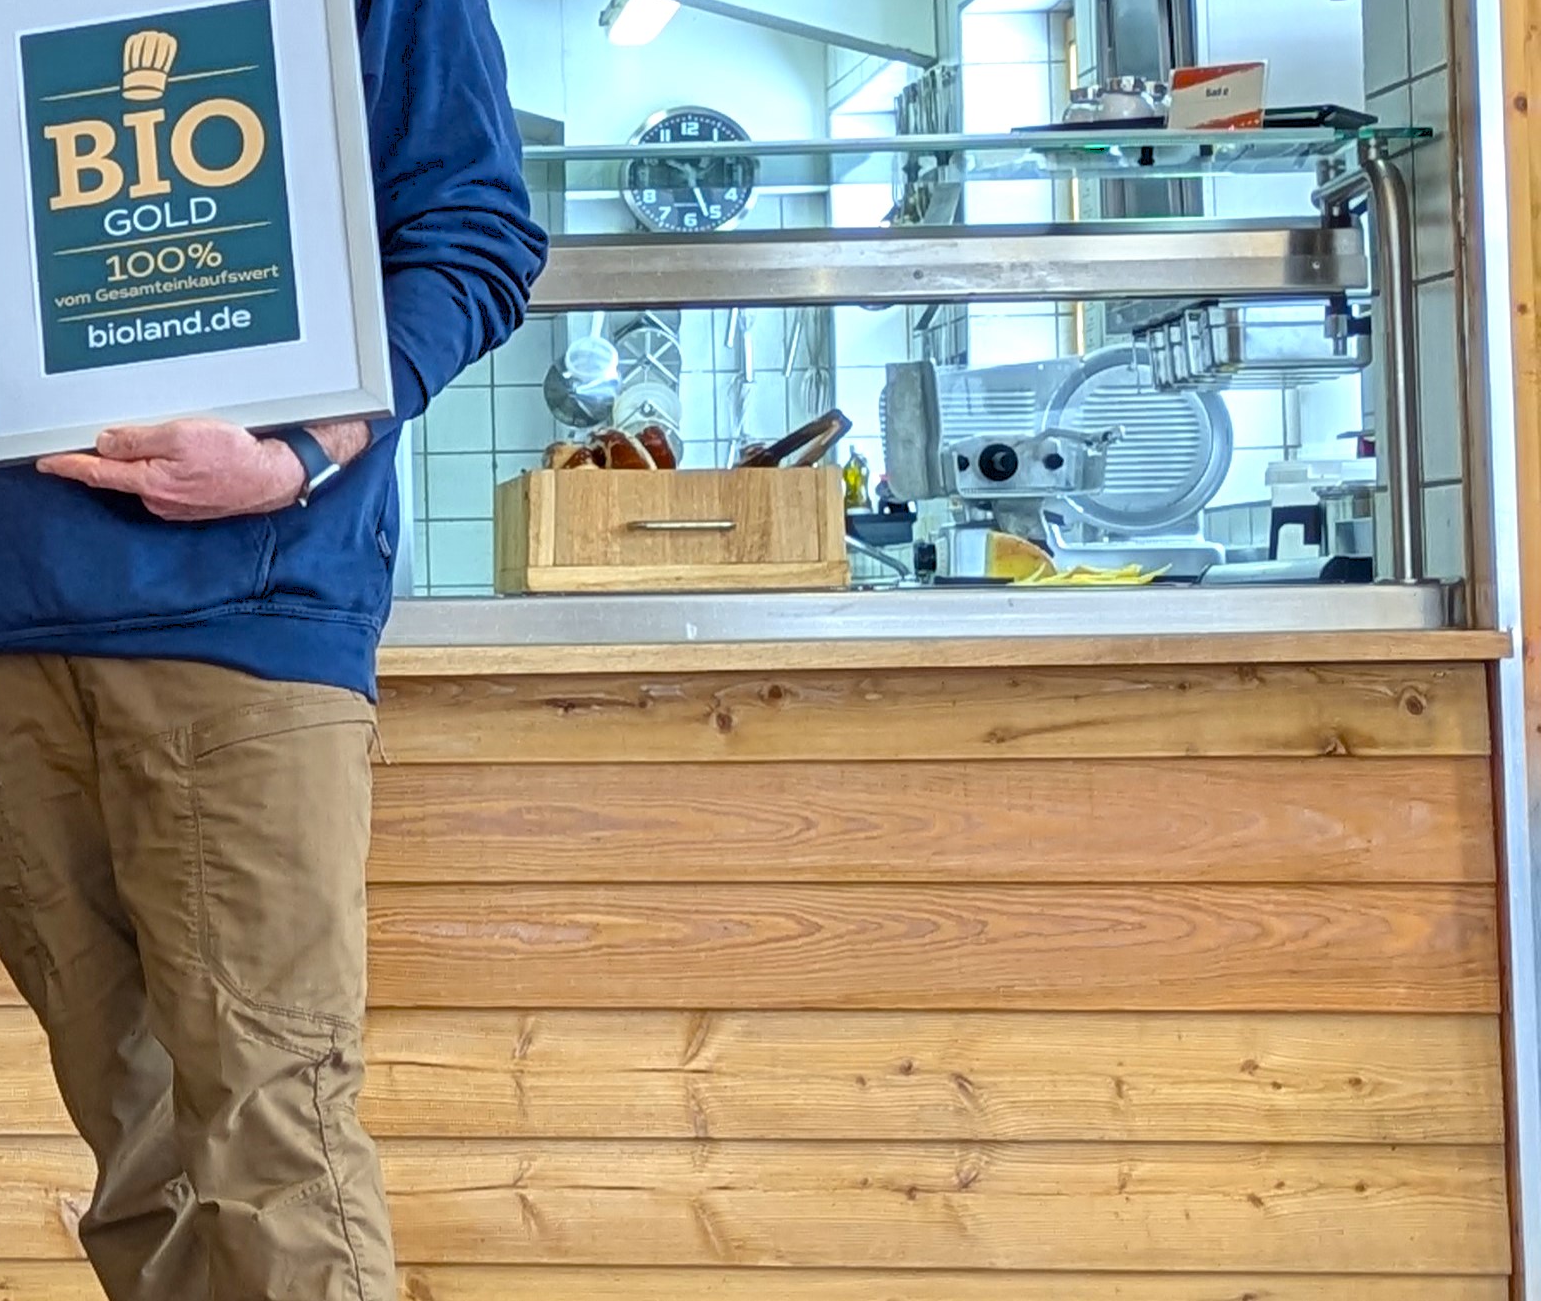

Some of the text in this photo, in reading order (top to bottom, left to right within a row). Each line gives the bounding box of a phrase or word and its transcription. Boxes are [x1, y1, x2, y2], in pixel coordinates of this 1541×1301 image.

[681, 121, 699, 136] 12
[44, 98, 265, 210] BIO
[642, 189, 657, 203] 8
[724, 187, 738, 201] 4
[103, 197, 218, 237] GOLD
[658, 205, 672, 221] 7
[683, 212, 698, 227] 6
[709, 204, 722, 219] 5
[105, 241, 223, 282] 100%
[54, 264, 280, 309] vom Gesamteinkaufswert
[87, 306, 252, 349] bioland.de
